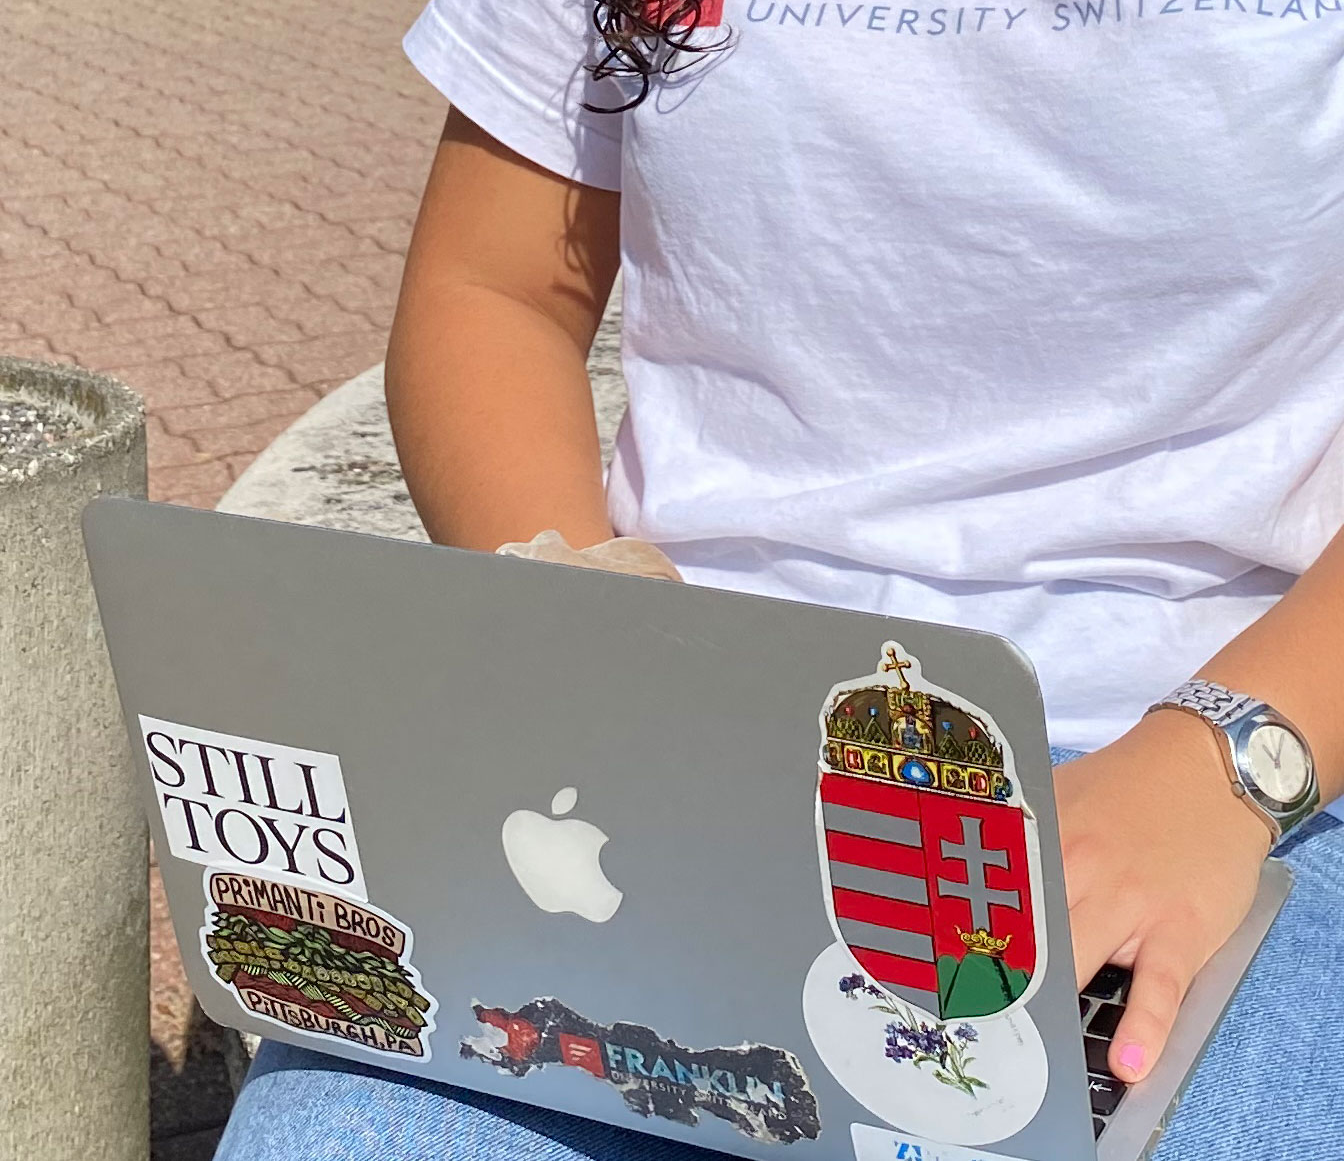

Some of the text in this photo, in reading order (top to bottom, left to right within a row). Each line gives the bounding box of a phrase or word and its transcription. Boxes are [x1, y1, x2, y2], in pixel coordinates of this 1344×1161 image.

[146, 731, 346, 824] STILL
[163, 793, 355, 885] TOYS
[335, 902, 396, 948] BROS
